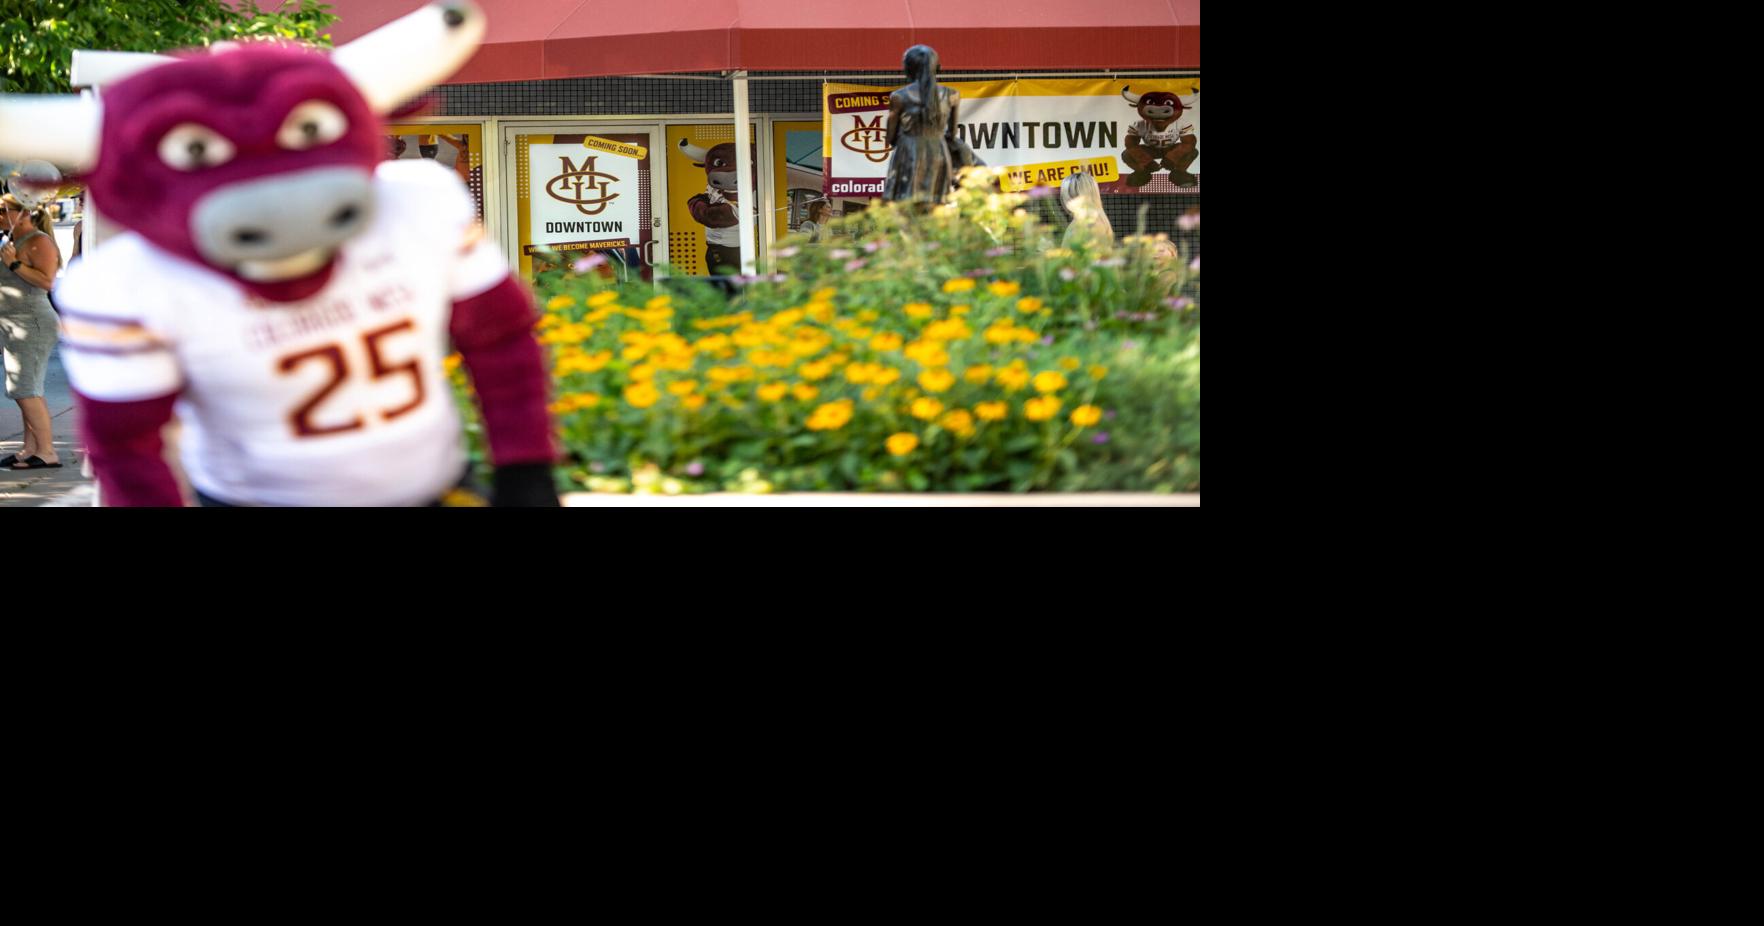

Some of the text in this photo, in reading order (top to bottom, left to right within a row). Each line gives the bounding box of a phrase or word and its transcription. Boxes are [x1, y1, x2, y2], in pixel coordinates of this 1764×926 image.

[835, 96, 880, 109] COMING
[957, 121, 1118, 149] WNTOWN
[588, 139, 617, 151] COMING
[1038, 167, 1065, 182] ARE
[832, 180, 885, 193] colorad
[546, 221, 623, 233] DOWNTOWN
[563, 243, 588, 251] BECOME
[275, 318, 427, 437] 25
